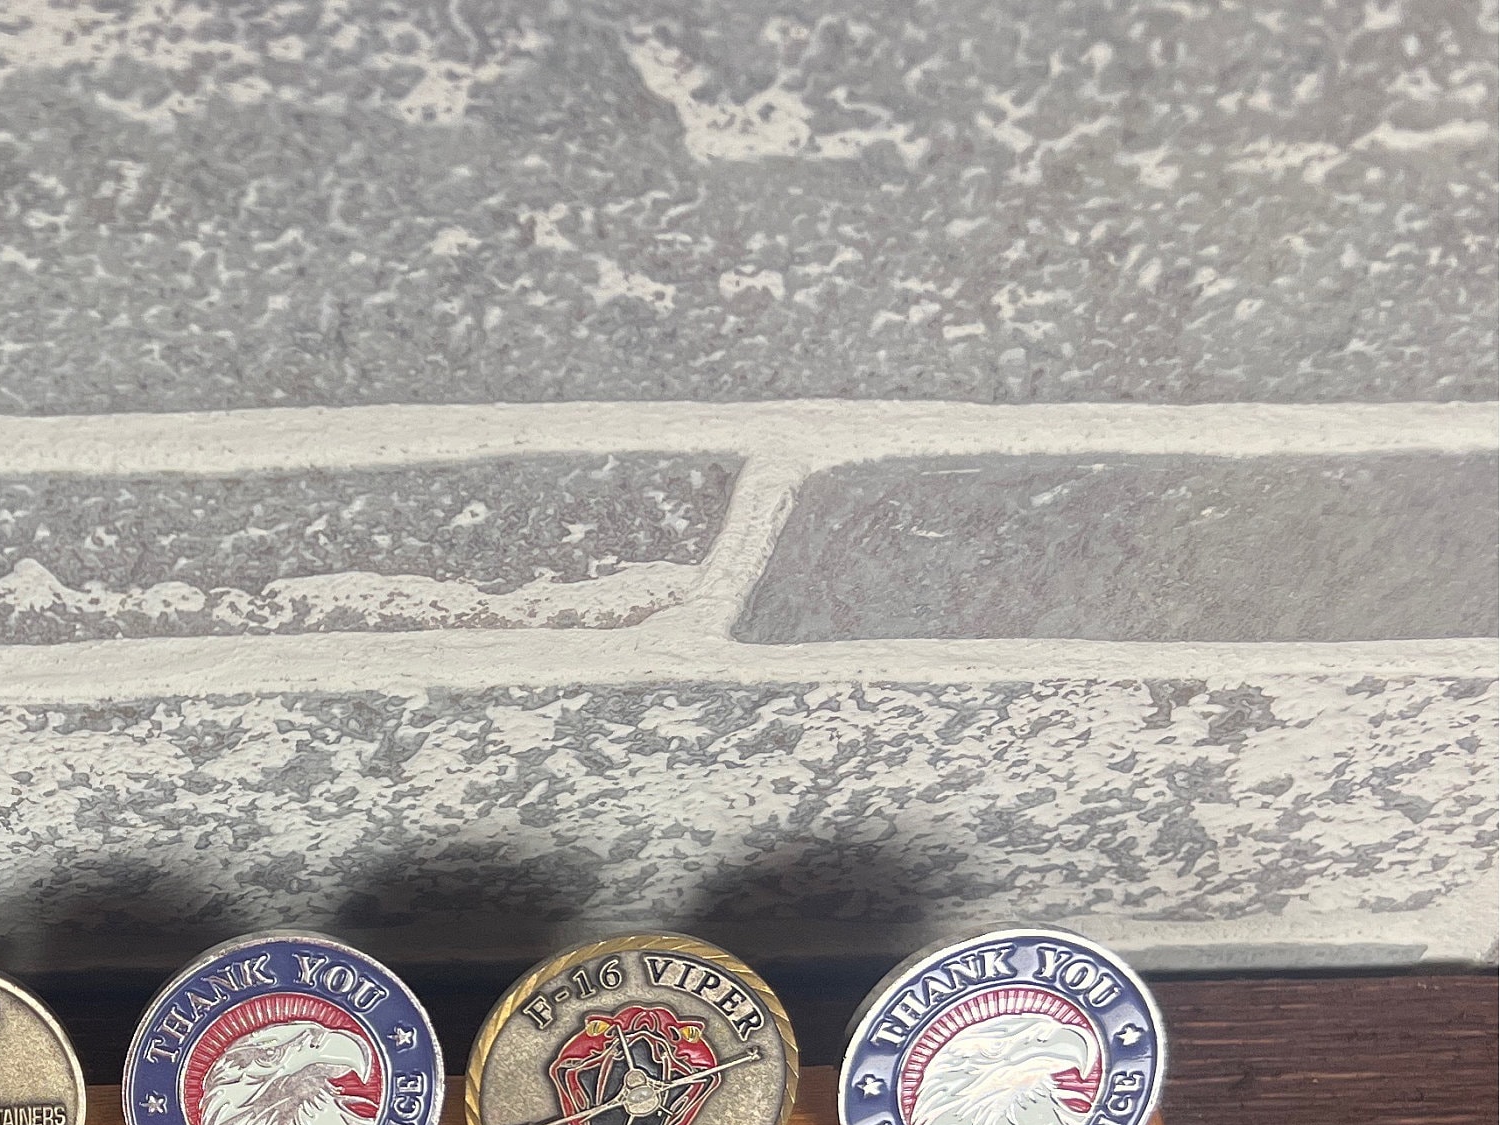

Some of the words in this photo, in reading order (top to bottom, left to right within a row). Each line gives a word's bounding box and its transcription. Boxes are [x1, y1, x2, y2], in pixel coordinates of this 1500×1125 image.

[144, 951, 276, 1064] THANK
[293, 952, 389, 1014] YOU
[523, 958, 623, 1030] F-16
[643, 955, 764, 1042] VIPER
[870, 944, 1017, 1048] THANK
[1036, 946, 1123, 1008] YOU
